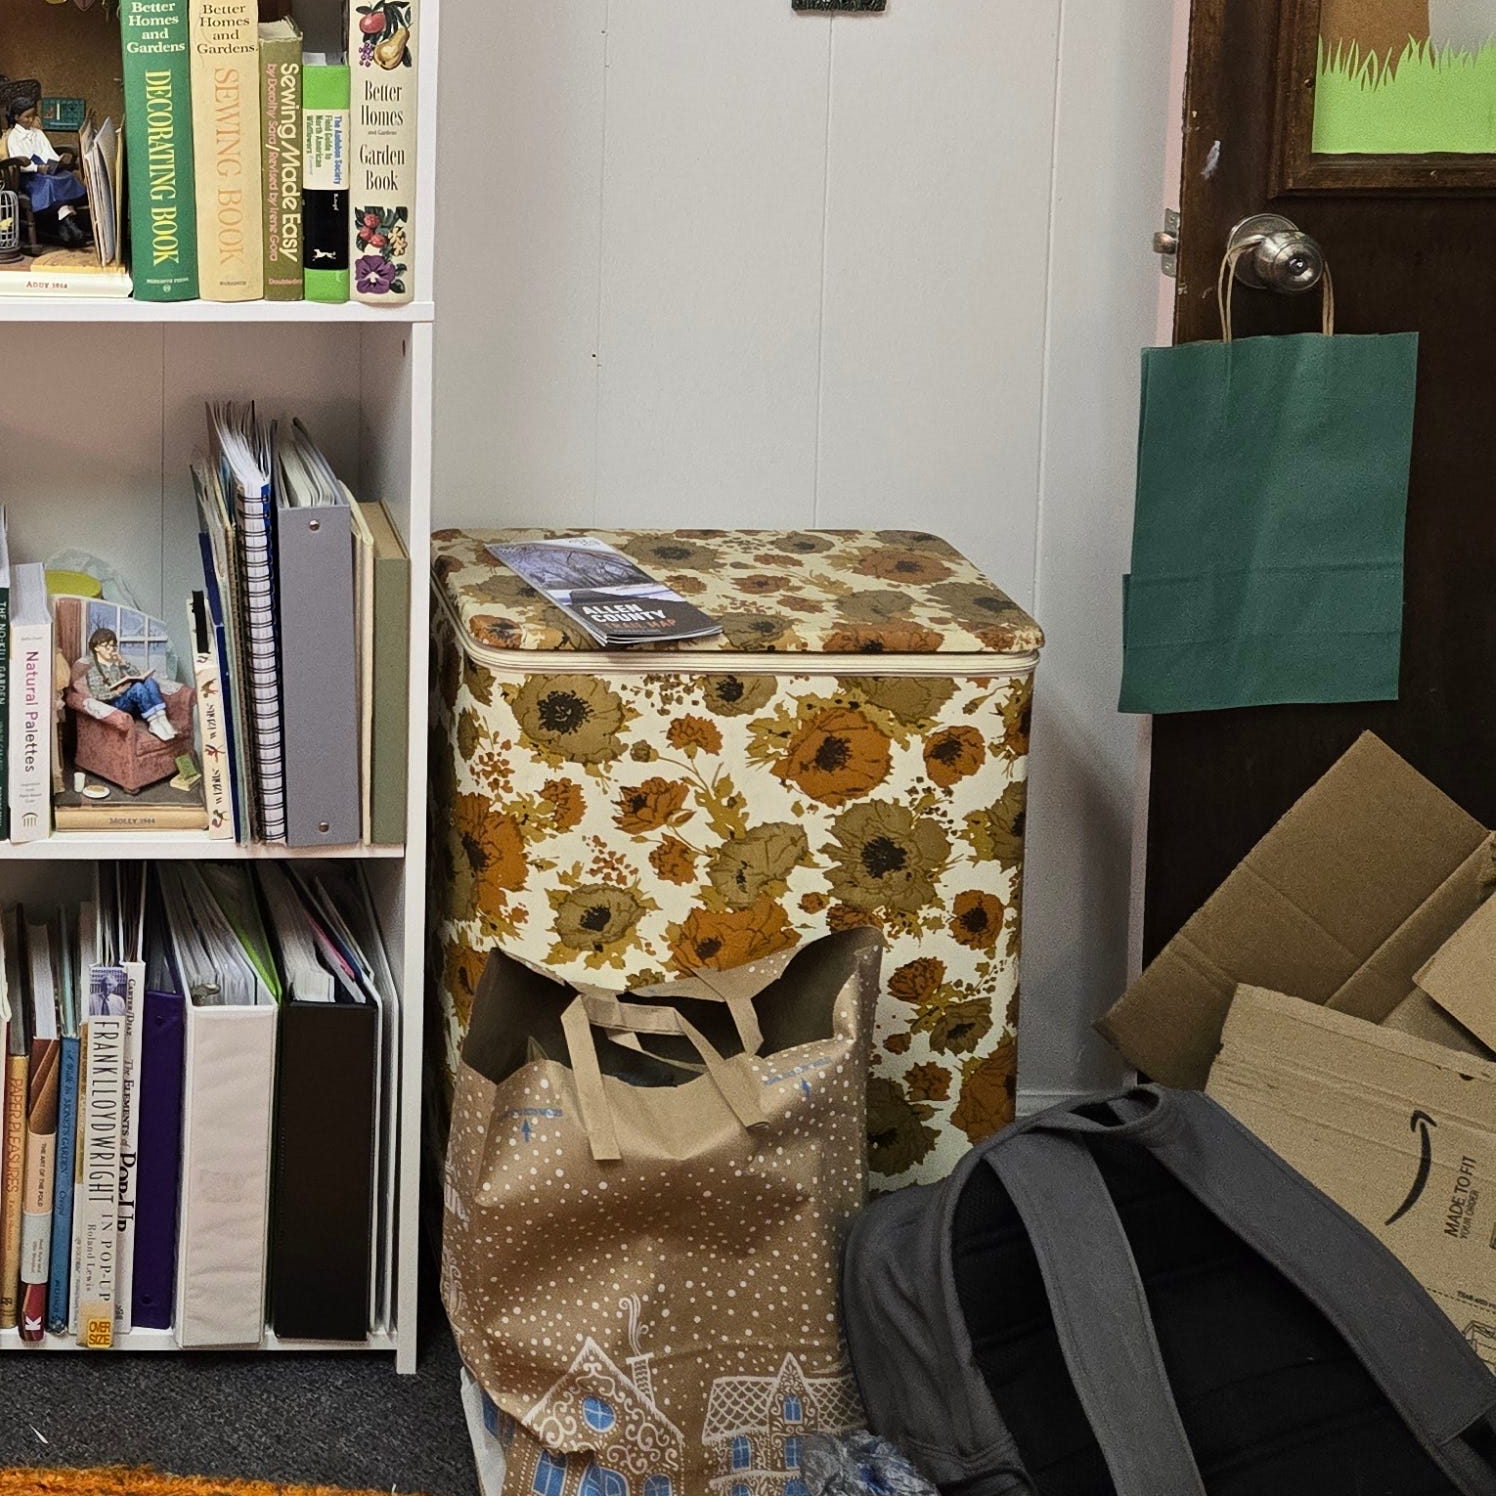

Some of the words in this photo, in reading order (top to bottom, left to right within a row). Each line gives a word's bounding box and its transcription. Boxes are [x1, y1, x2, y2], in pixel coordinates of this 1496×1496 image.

[132, 1, 176, 14] Better
[203, 4, 246, 15] Better
[128, 14, 179, 27] Homes
[200, 16, 250, 28] Homes
[141, 28, 169, 40] and
[212, 29, 239, 40] and
[126, 40, 185, 54] Gardens
[267, 64, 278, 77] by
[266, 78, 278, 118] Dorothy
[277, 63, 299, 139] Sewing
[365, 80, 402, 101] Better
[214, 67, 242, 179] SEWING
[325, 115, 333, 131] Field
[334, 115, 342, 128] The
[361, 105, 404, 126] Homes
[145, 68, 176, 200] DECORATING
[306, 115, 314, 154] Wildflowers
[325, 133, 333, 152] Guide
[359, 144, 405, 166] Garden
[281, 141, 301, 210] Made
[333, 159, 342, 185] Society
[366, 170, 399, 191] Book
[267, 192, 278, 206] by
[217, 184, 244, 265] BOOK
[269, 208, 279, 231] Irene
[151, 205, 179, 266] BOOK
[279, 213, 301, 262] Easy
[269, 234, 280, 261] Gora
[582, 603, 642, 616] ALLEN
[590, 609, 666, 623] COUNTY
[25, 651, 39, 705] Natural
[24, 711, 39, 772] Palettes
[123, 1059, 134, 1076] The
[8, 1078, 23, 1119] PAPER
[6, 1124, 22, 1192] PLEASURES
[39, 1144, 47, 1154] THE
[39, 1155, 47, 1165] ART
[1460, 1155, 1477, 1176] FIT
[1454, 1176, 1470, 1194] TO
[37, 1190, 45, 1207] FOLD
[101, 1209, 113, 1232] IN
[1444, 1197, 1465, 1238] MADE
[87, 1224, 97, 1264] Roland
[99, 1240, 112, 1301] POP-UP
[89, 1321, 111, 1333] OVER
[89, 1334, 111, 1345] SIZE
